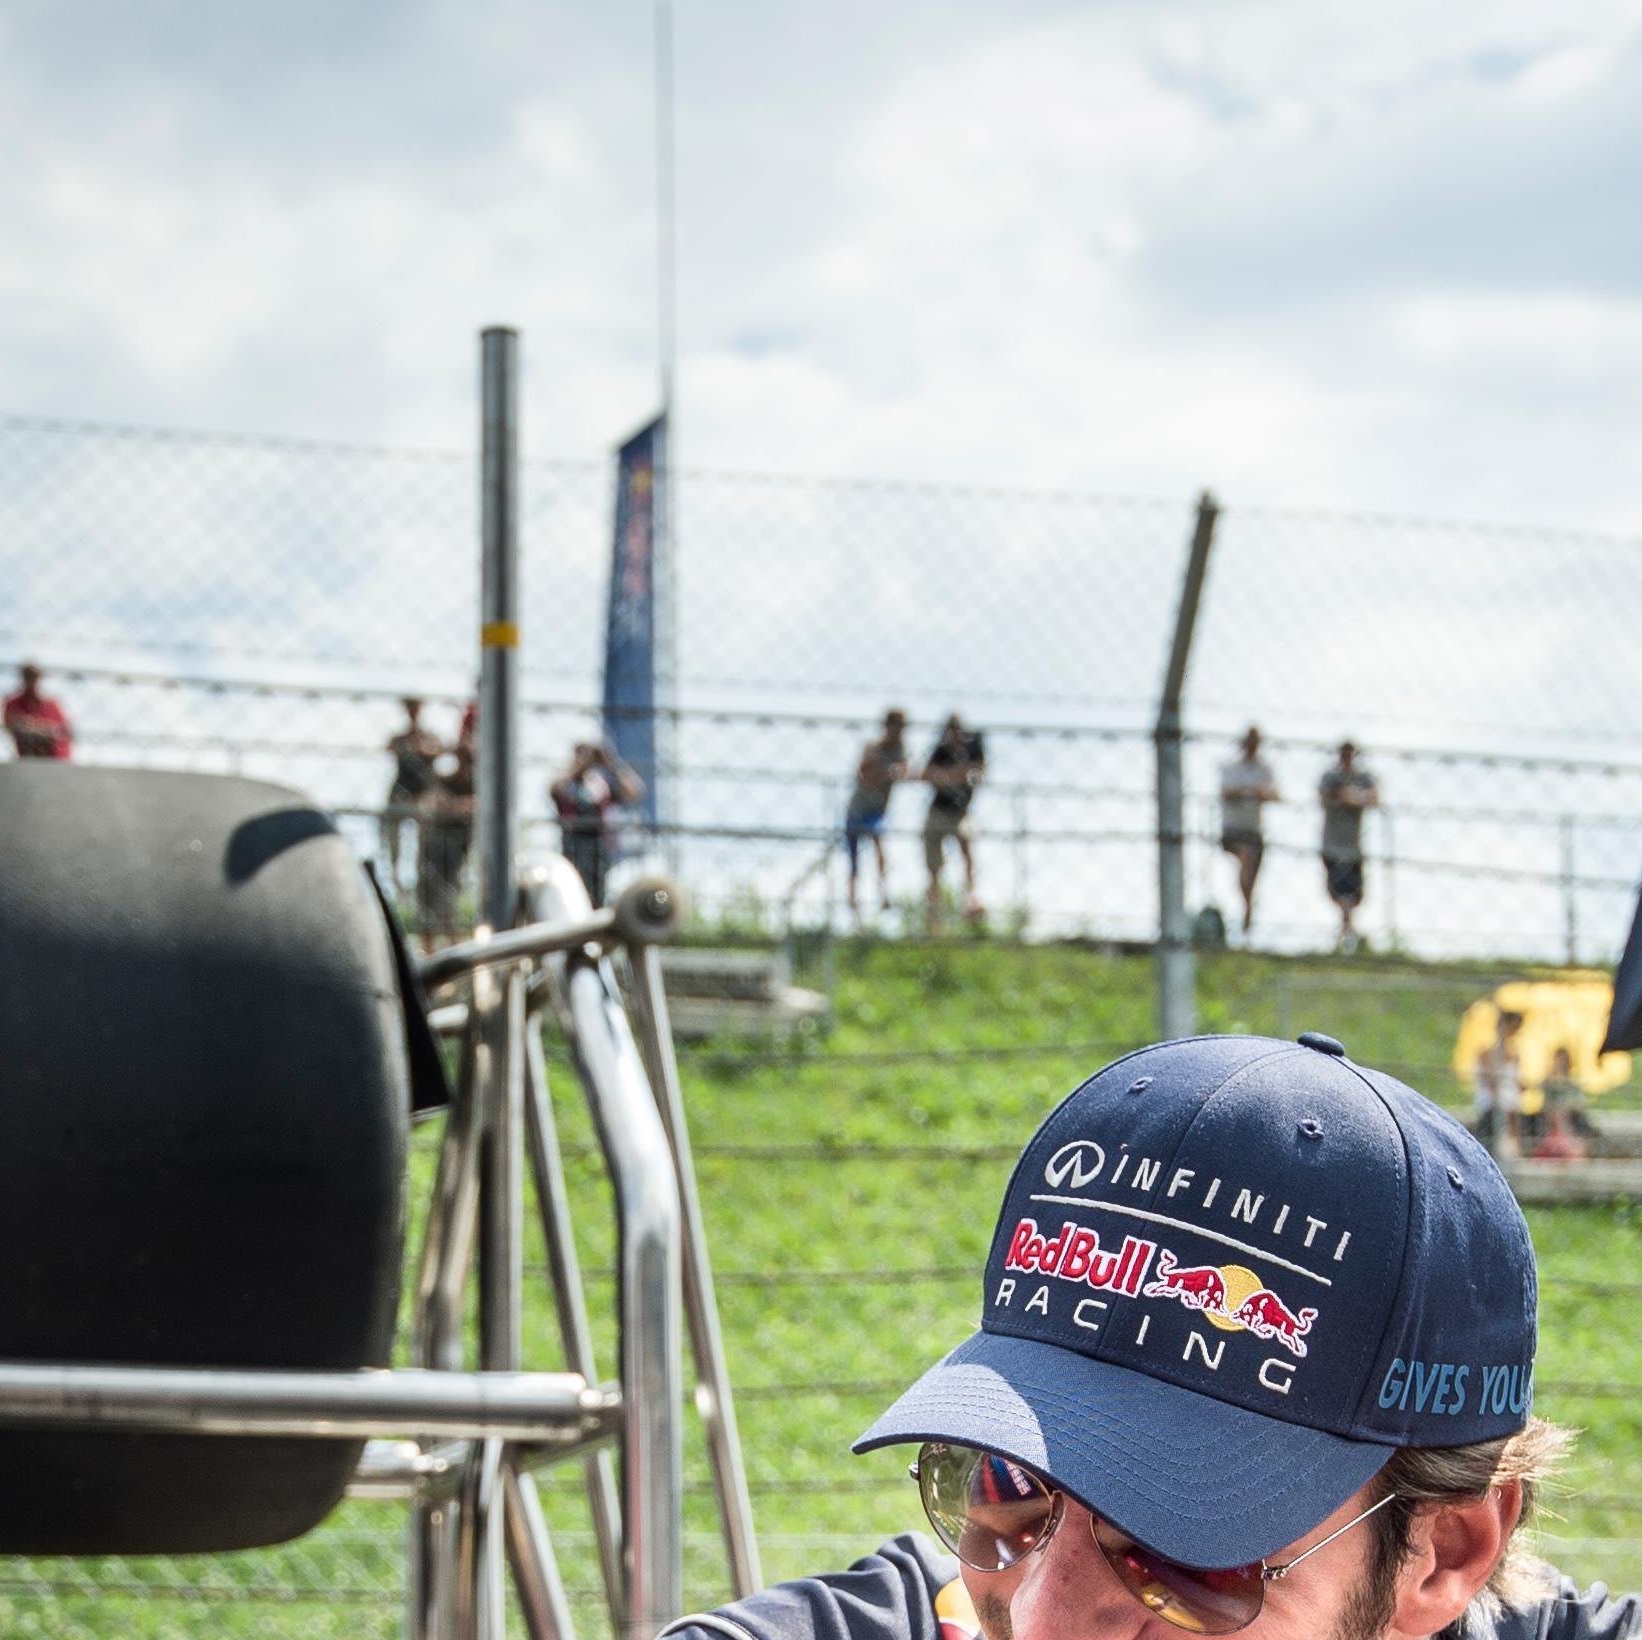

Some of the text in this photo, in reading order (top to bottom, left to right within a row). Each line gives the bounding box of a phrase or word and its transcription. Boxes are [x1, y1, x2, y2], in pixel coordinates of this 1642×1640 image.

[1110, 1147, 1352, 1261] INFINITI
[995, 1279, 1297, 1395] RACING
[1378, 1357, 1470, 1416] GIVES
